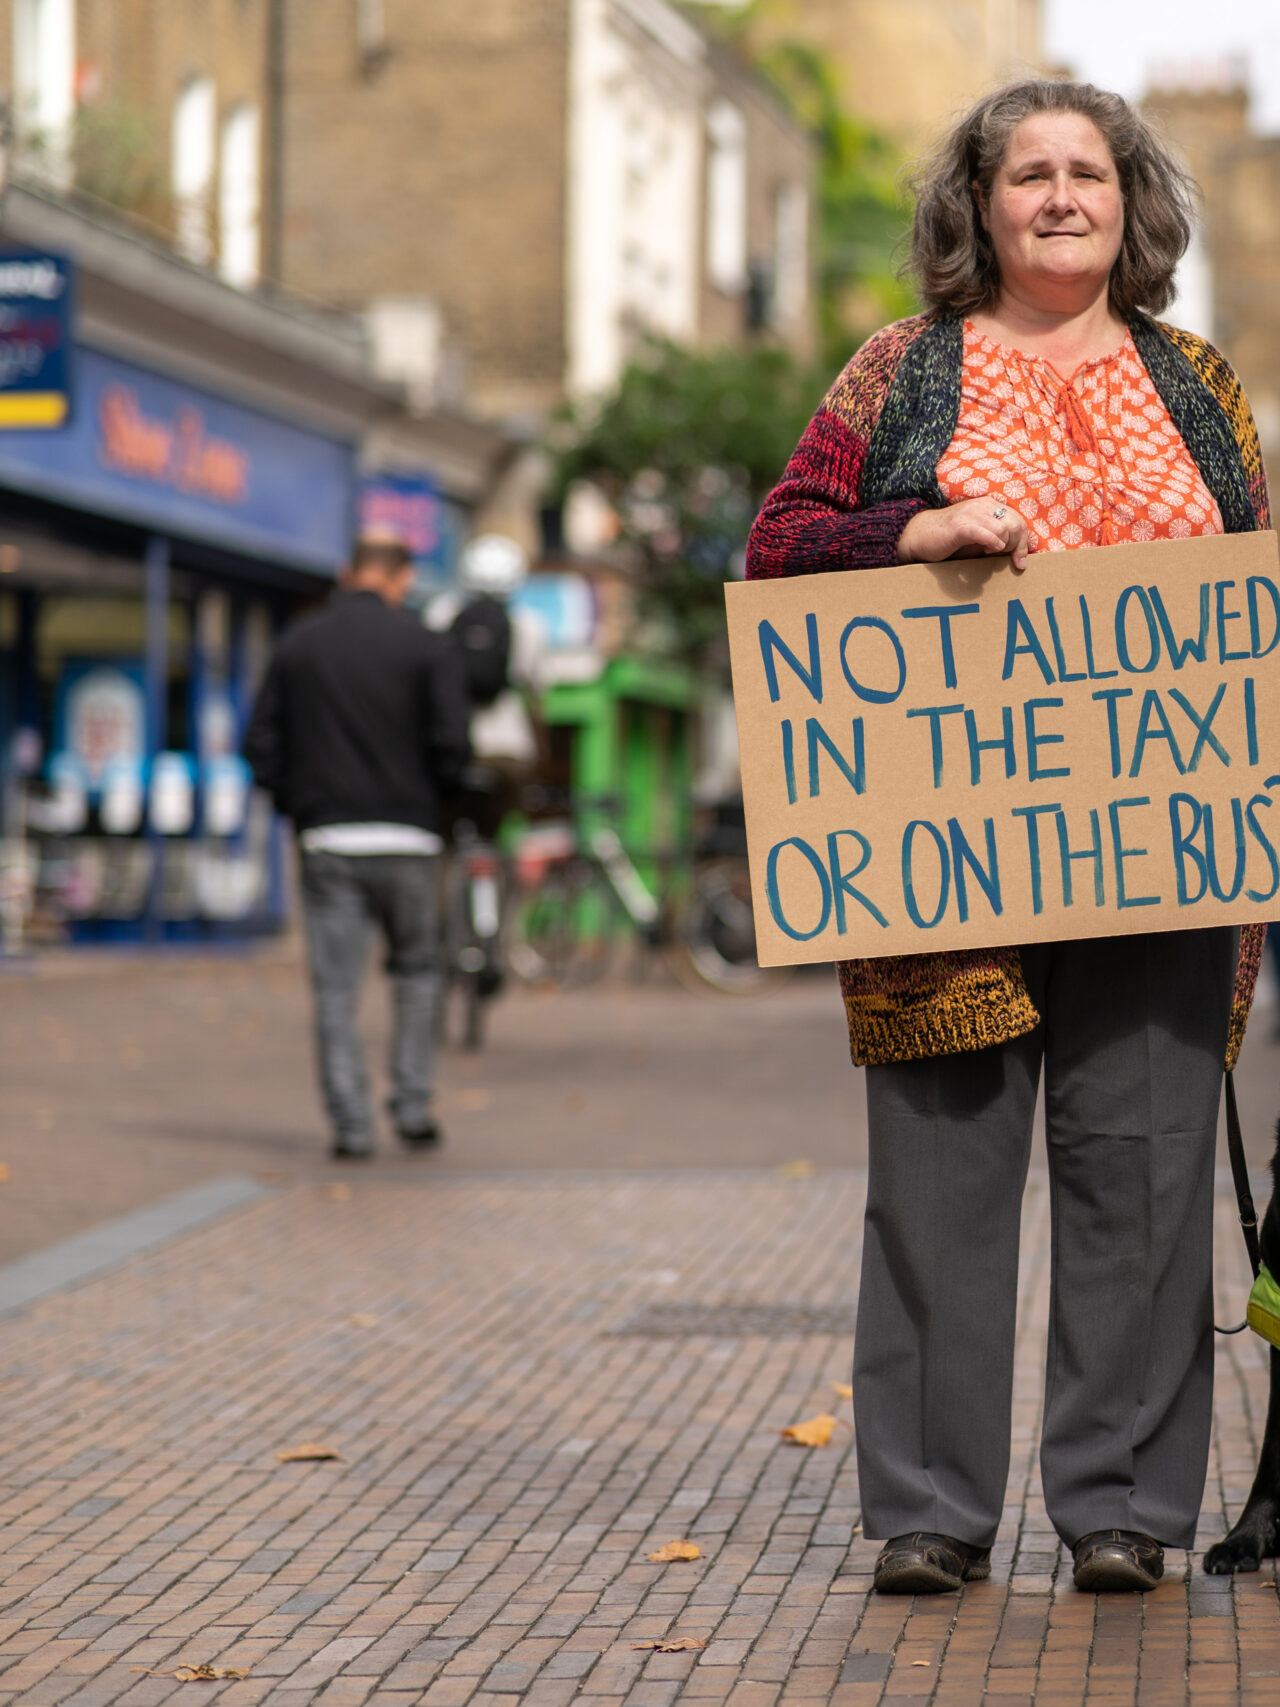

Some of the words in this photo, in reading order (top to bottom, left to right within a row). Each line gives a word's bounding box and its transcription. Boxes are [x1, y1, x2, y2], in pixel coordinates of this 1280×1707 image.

[758, 603, 980, 705] NOT
[781, 716, 866, 804] IN
[906, 695, 1071, 789] THE
[1091, 677, 1260, 779] TAXI
[766, 829, 889, 942] OR
[901, 817, 1004, 929] ON
[1011, 796, 1162, 915] THE
